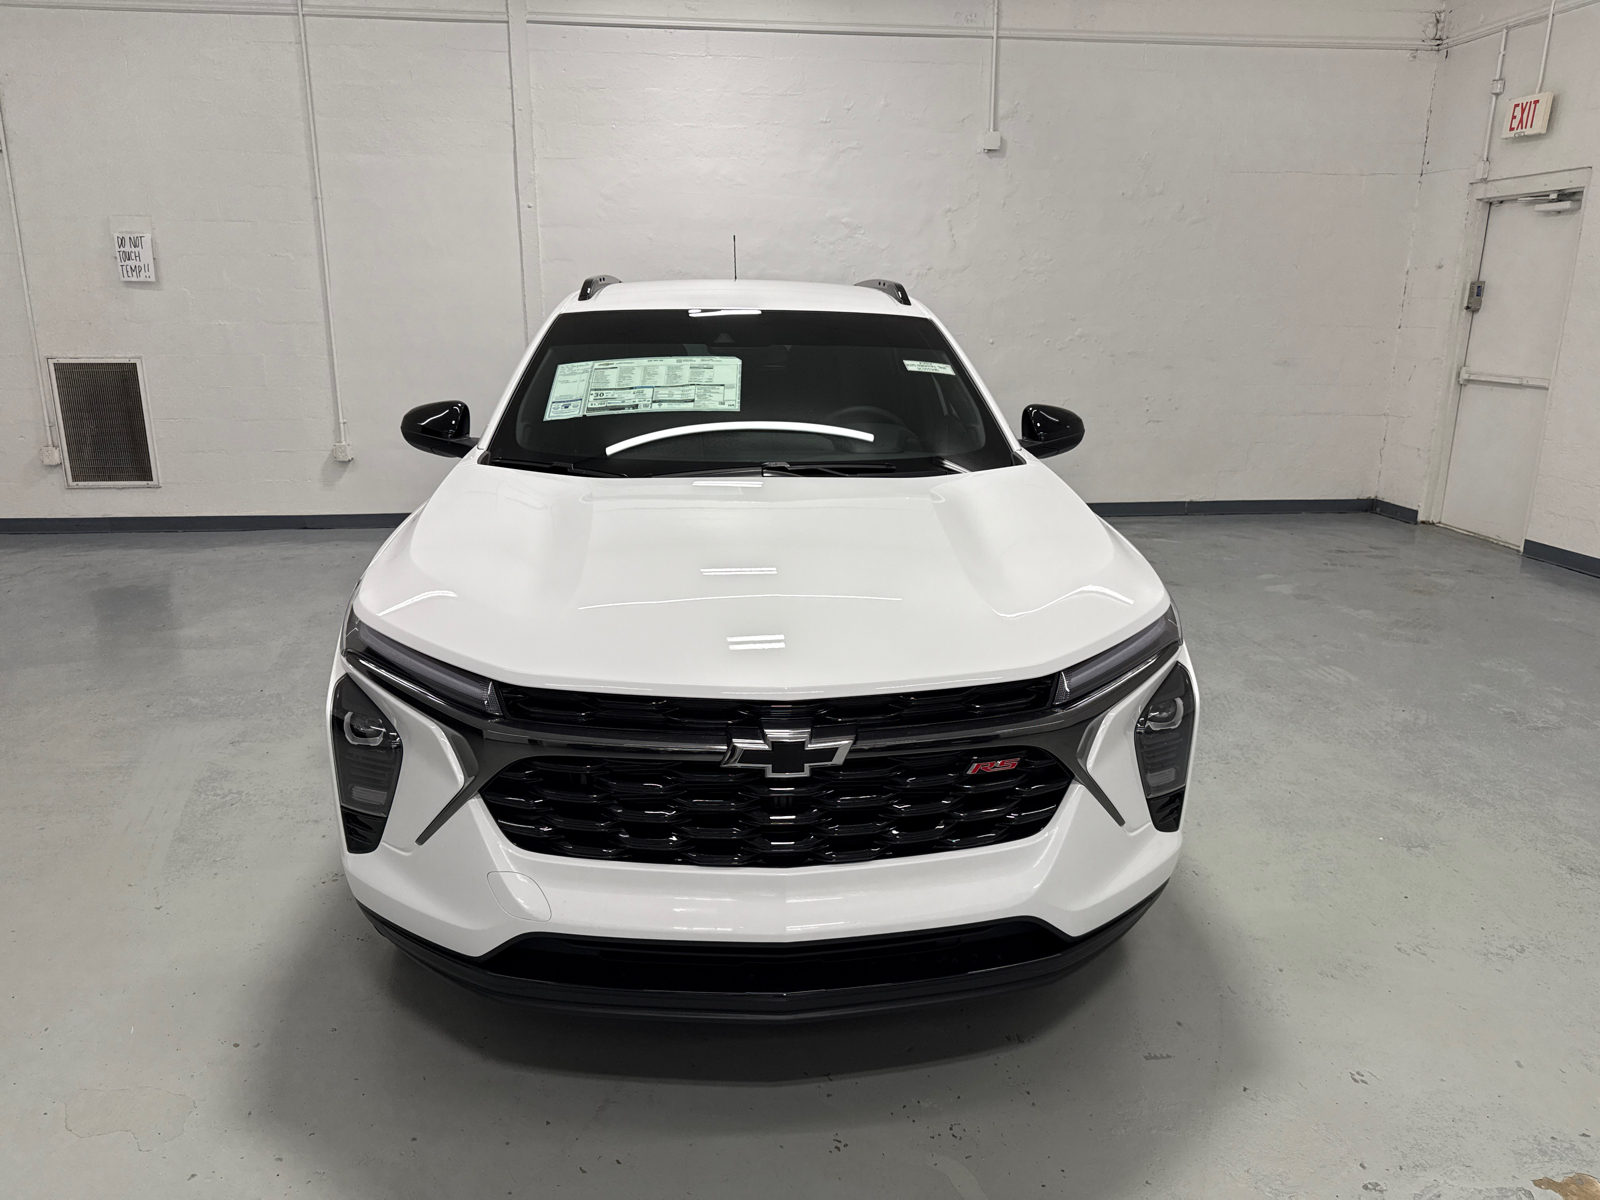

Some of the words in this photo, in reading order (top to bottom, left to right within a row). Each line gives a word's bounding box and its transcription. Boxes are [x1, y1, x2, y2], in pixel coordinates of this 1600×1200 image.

[1509, 99, 1540, 132] EXIT
[117, 236, 126, 249] DO
[129, 235, 145, 249] NOT
[117, 250, 141, 263] TOUCH
[120, 263, 151, 279] TEMP!!
[966, 757, 1021, 774] RS
